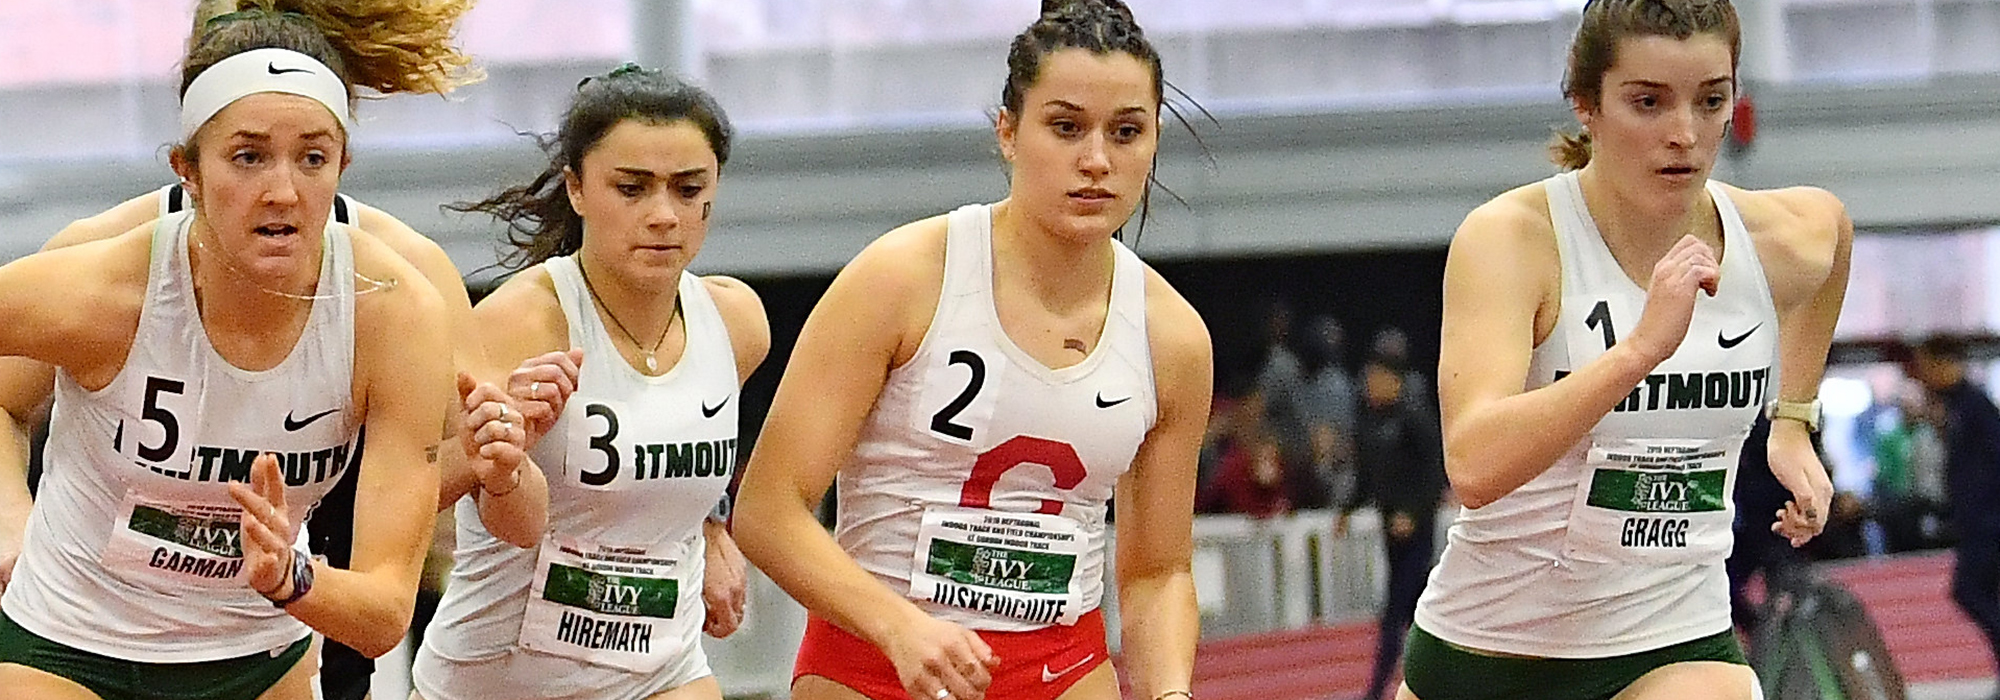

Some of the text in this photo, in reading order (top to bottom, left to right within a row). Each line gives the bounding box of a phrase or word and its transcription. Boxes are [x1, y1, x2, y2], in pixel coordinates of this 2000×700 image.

[1585, 300, 1617, 351] 1
[931, 350, 985, 441] 2
[137, 376, 185, 462] 5
[580, 403, 620, 485] 3
[959, 434, 1087, 516] C
[1648, 481, 1689, 501] IVY
[1647, 501, 1690, 511] LEAGUE
[192, 526, 239, 546] IVY
[969, 524, 990, 532] TRACK
[1621, 517, 1689, 547] GRAGG
[149, 546, 245, 579] GARMAN
[987, 558, 1034, 580] IVY
[602, 584, 643, 605] IVY
[984, 578, 1032, 592] LEAGUE
[600, 602, 640, 614] LEAGUE
[557, 610, 652, 654] HIREMATH
